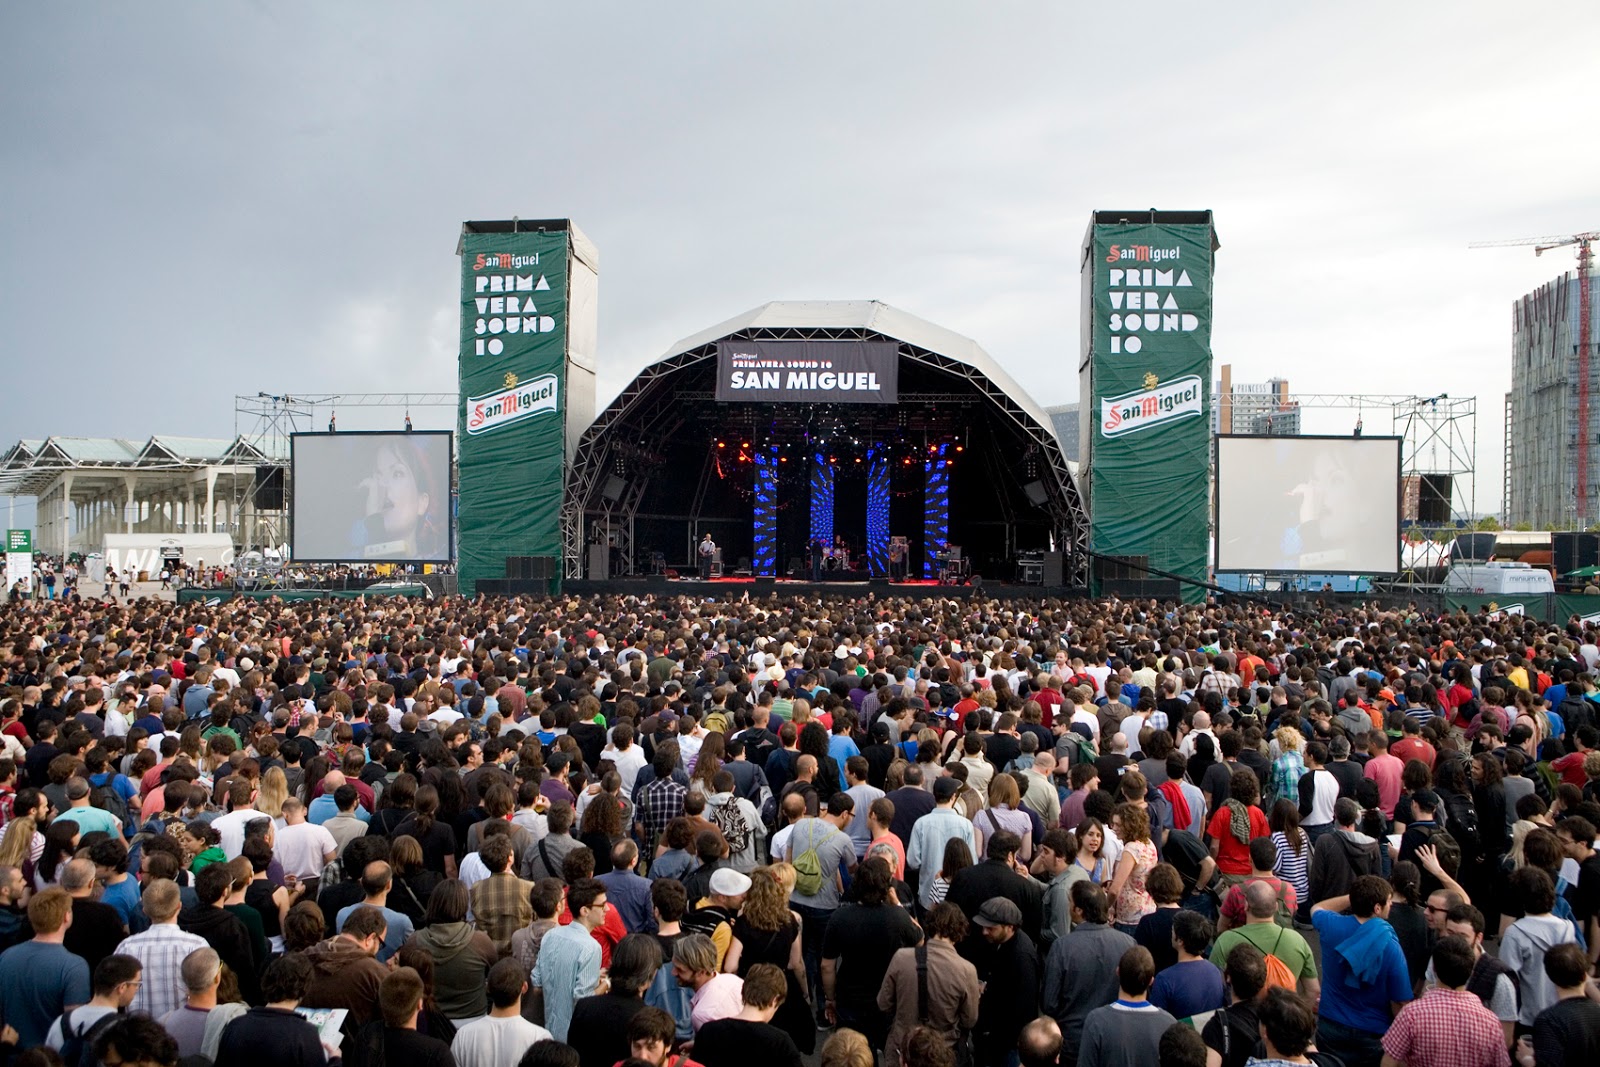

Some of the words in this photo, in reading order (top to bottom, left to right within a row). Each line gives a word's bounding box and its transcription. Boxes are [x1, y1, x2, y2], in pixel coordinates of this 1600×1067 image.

[475, 274, 550, 293] PRIMA
[1109, 268, 1193, 287] PRIMA
[474, 296, 537, 314] VERA
[1108, 291, 1179, 310] VERA
[474, 316, 555, 335] SOUND
[1108, 313, 1199, 332] SOUND
[787, 360, 818, 369] SOUND
[730, 371, 780, 390] SAN
[786, 372, 881, 391] MIGUEL
[1237, 384, 1267, 393] PRINCESS
